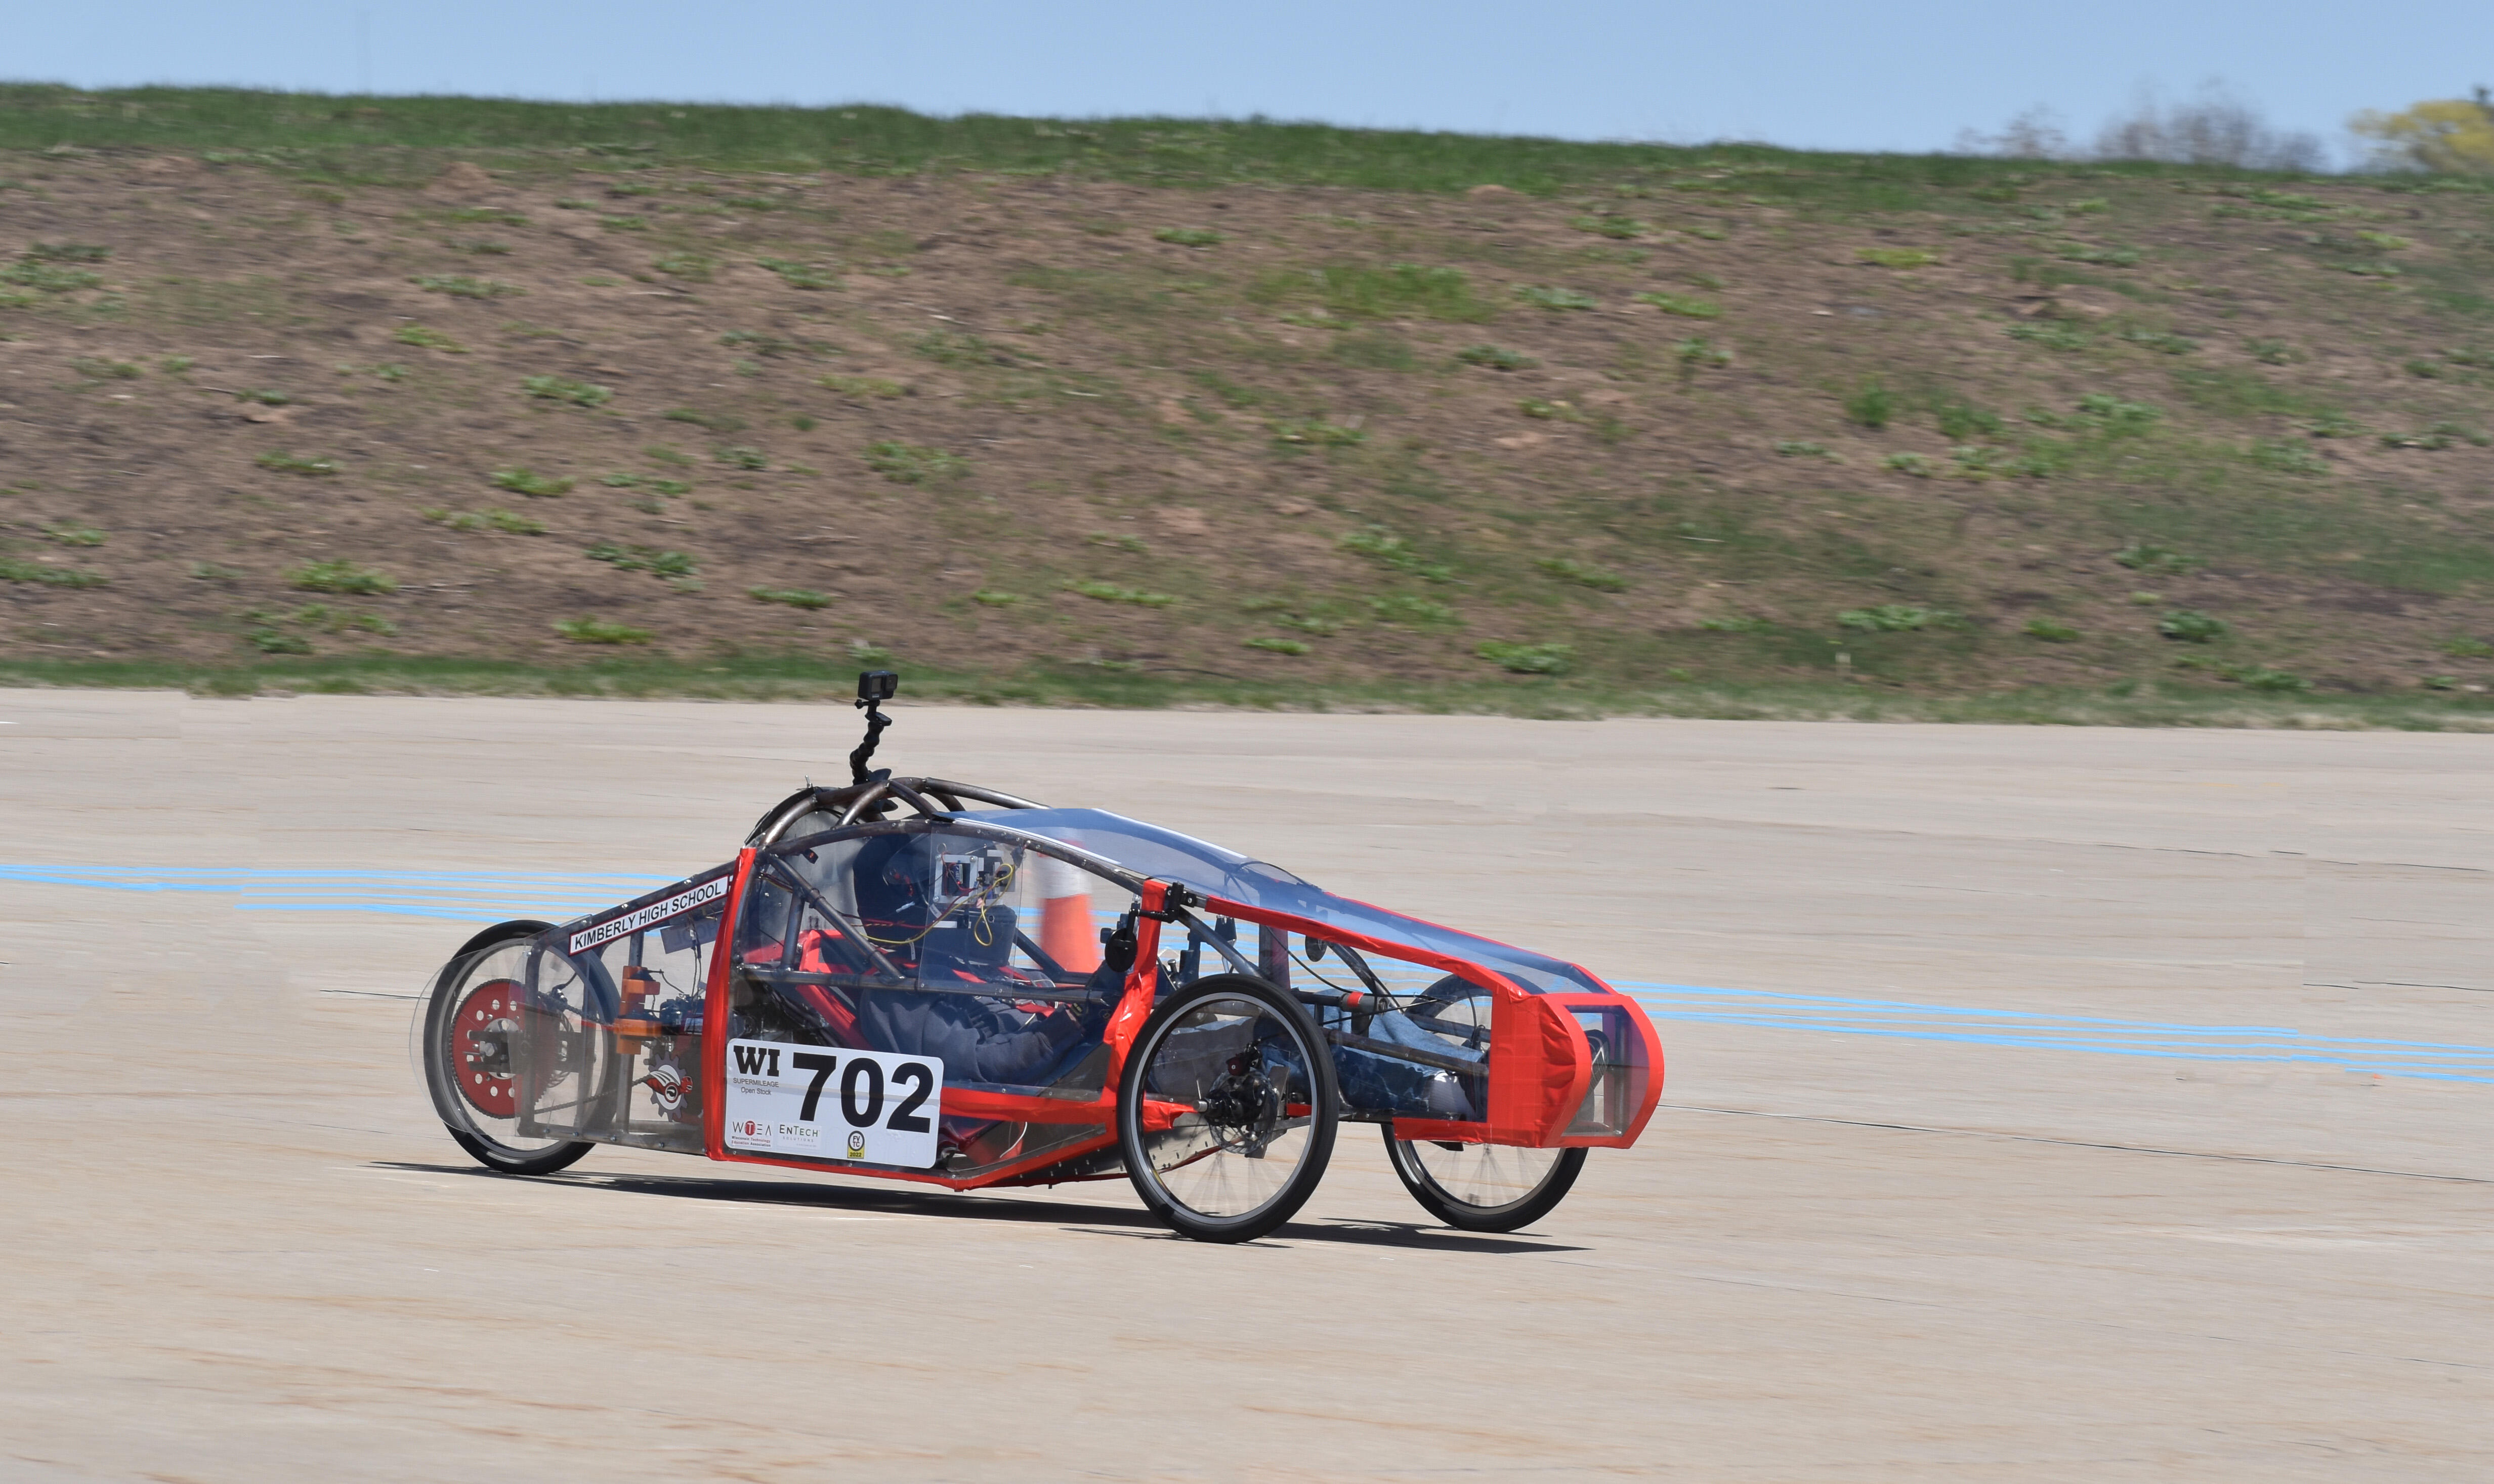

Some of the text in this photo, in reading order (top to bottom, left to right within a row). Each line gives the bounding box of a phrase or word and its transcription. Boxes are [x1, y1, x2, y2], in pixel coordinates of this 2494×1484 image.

[575, 882, 722, 950] KIMBERLY HIGH SCHOOL
[733, 1045, 780, 1077] WI
[733, 1077, 779, 1087] SUPERMILEAGE
[792, 1052, 934, 1133] 702
